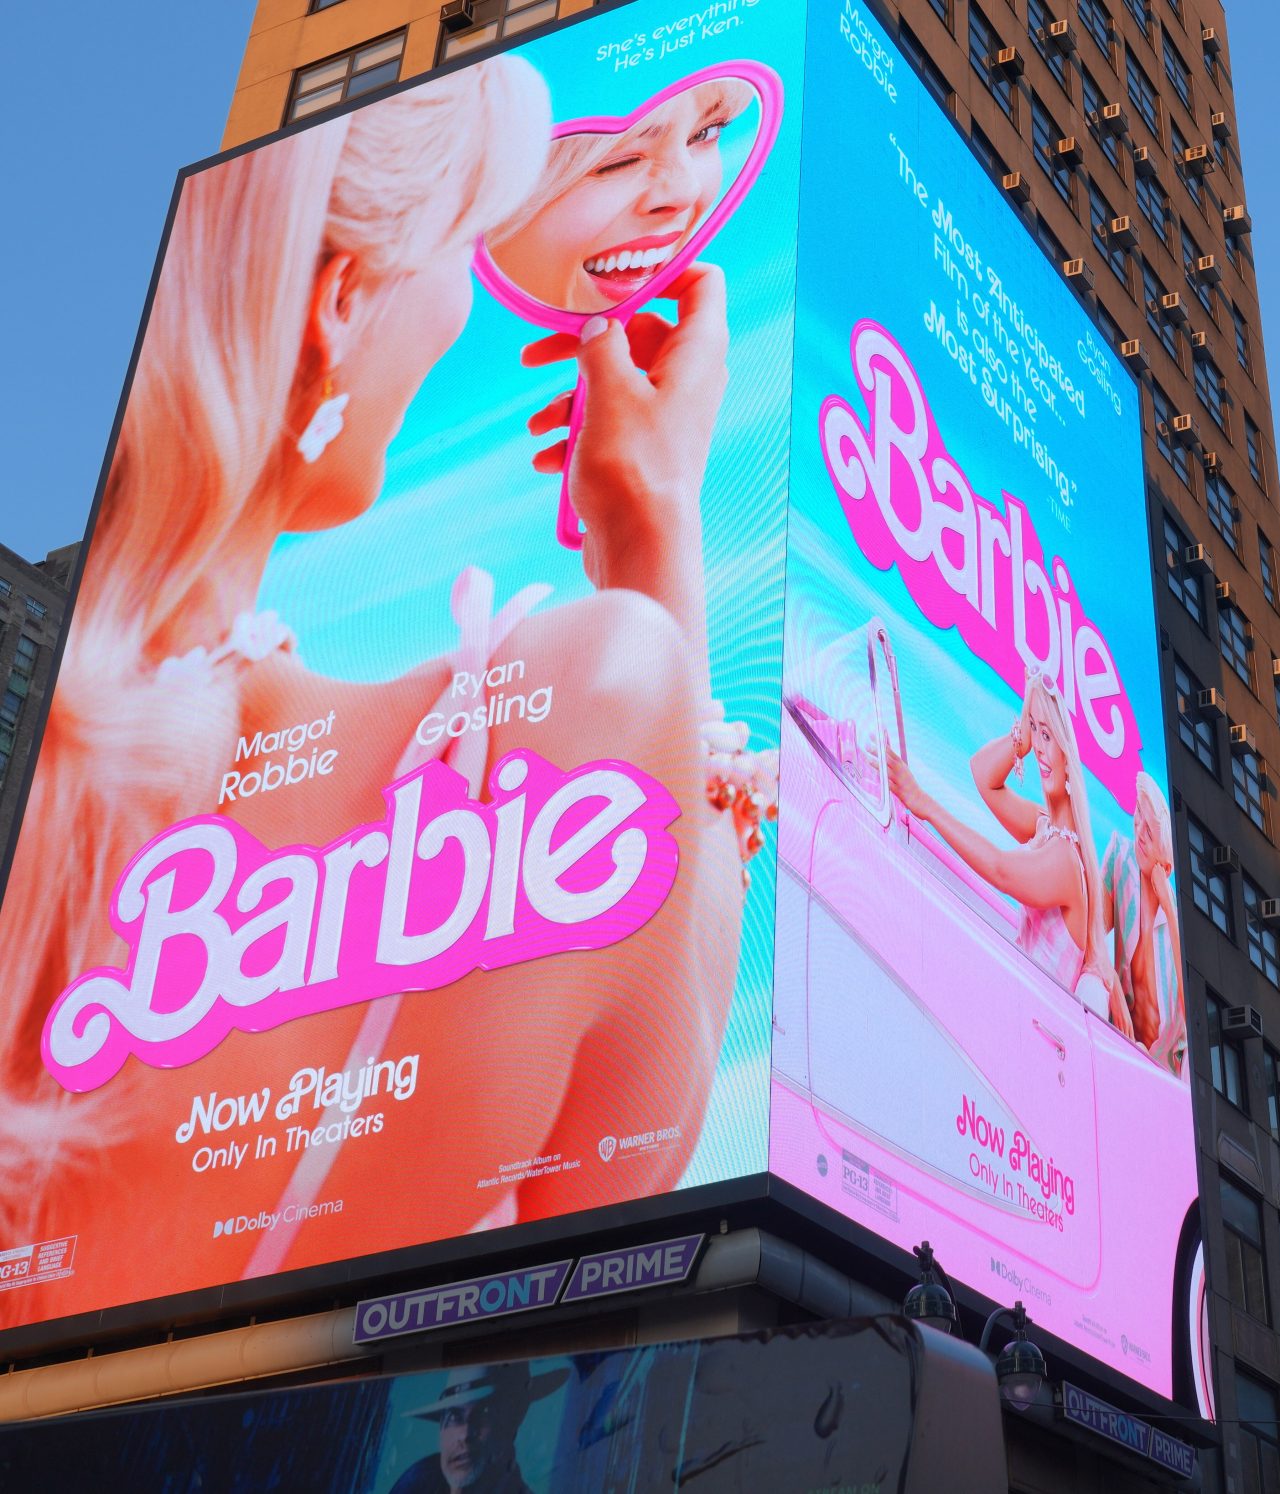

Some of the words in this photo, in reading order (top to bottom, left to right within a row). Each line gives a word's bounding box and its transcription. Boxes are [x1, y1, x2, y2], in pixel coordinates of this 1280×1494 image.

[596, 33, 647, 61] She's
[614, 47, 655, 72] He's
[659, 29, 696, 60] just
[701, 14, 744, 40] Ken.
[840, 12, 897, 104] Robbie
[845, 0, 894, 74] Margot
[931, 197, 983, 282] Most
[986, 266, 1086, 419] Anticipated
[933, 232, 969, 300] Film
[972, 292, 990, 326] of
[992, 312, 1019, 364] the
[1021, 346, 1067, 427] Year...
[923, 299, 977, 385] Most
[956, 299, 969, 336] is
[972, 328, 1008, 384] also
[1011, 369, 1038, 423] the
[1086, 330, 1111, 376] Ryan
[1077, 339, 1122, 417] Gosling
[823, 326, 1126, 760] Barbie
[450, 659, 525, 699] Ryan
[234, 710, 336, 762] Margot
[414, 685, 553, 746] Gosling
[218, 747, 339, 805] Robbie
[49, 757, 649, 1067] Barbie
[175, 1087, 271, 1144] Now
[275, 1054, 420, 1121] Playing
[191, 1141, 249, 1173] Only
[254, 1134, 277, 1160] In
[286, 1112, 385, 1152] Theaters
[498, 1158, 532, 1173] Soundtrack
[533, 1155, 552, 1165] Album
[619, 1131, 655, 1150] WARNER
[956, 1093, 1005, 1158] Now
[1009, 1130, 1075, 1216] Playing
[476, 1177, 499, 1189] Atlantic
[562, 1160, 581, 1171] Music
[969, 1152, 999, 1194] Only
[1002, 1173, 1014, 1200] In
[1017, 1182, 1064, 1233] Theaters
[235, 1211, 281, 1234] Dolby
[283, 1199, 344, 1224] Cinema
[0, 1260, 29, 1279] G-13
[362, 1269, 557, 1335] OUTFRONT
[581, 1244, 687, 1293] PRIME
[1001, 1263, 1024, 1292] Dolby
[1023, 1277, 1052, 1305] Cinema
[1068, 1389, 1146, 1449] OUTFRONT
[1155, 1435, 1191, 1473] PRIME
